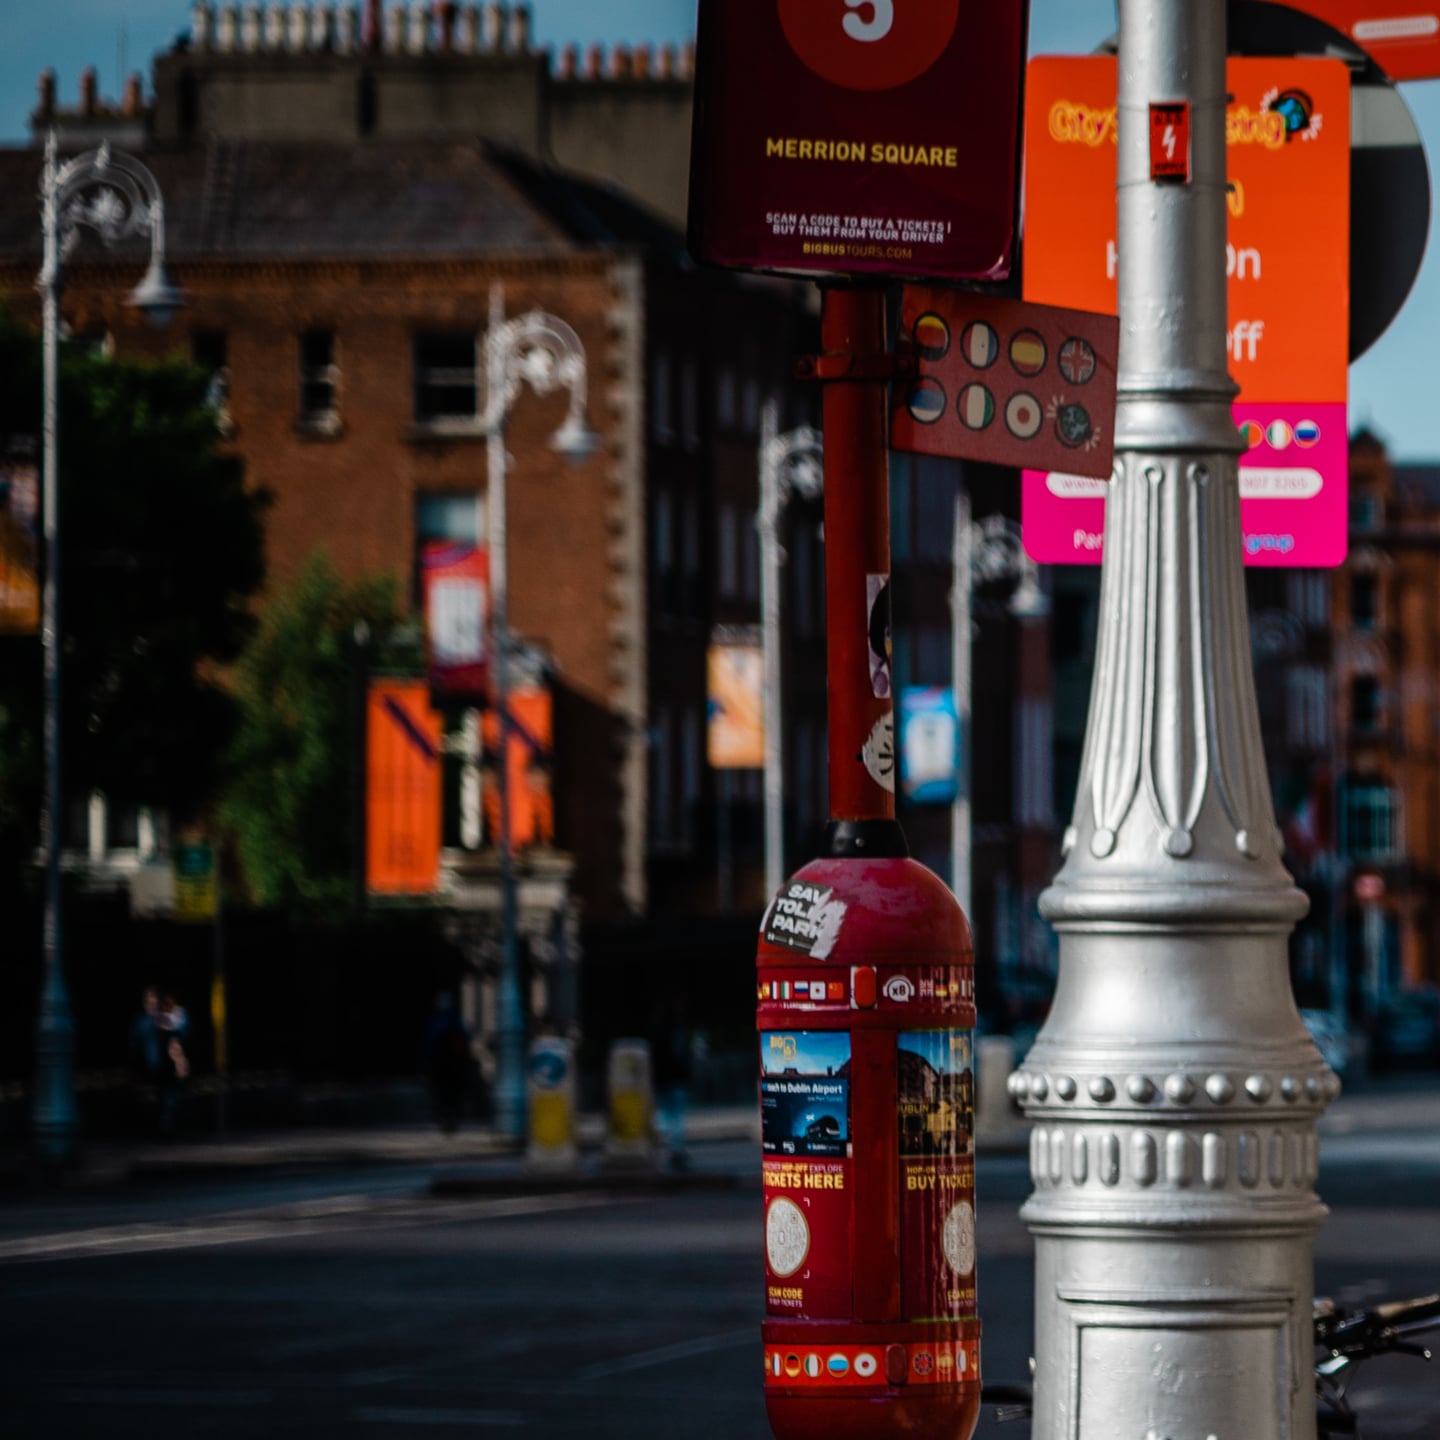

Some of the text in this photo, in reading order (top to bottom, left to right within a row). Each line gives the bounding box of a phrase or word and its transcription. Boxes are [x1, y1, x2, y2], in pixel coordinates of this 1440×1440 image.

[766, 138, 958, 167] MERRION SQUARE
[766, 212, 797, 225] SCAN
[799, 214, 808, 226] A
[810, 214, 840, 227] CODE
[844, 216, 857, 228] TO
[860, 217, 883, 229] BUY
[886, 219, 895, 230] A
[897, 220, 945, 233] TICKETS
[772, 224, 945, 244] BUY THEM FROM YOUR DRIVER
[802, 242, 913, 260] BIGBUSTOURS.COM
[892, 984, 906, 997] x8
[812, 1083, 842, 1096] Airport
[809, 1163, 844, 1174] EXPLORE
[803, 1173, 844, 1190] HERE
[907, 1175, 936, 1191] BUY
[782, 1287, 803, 1300] CODE
